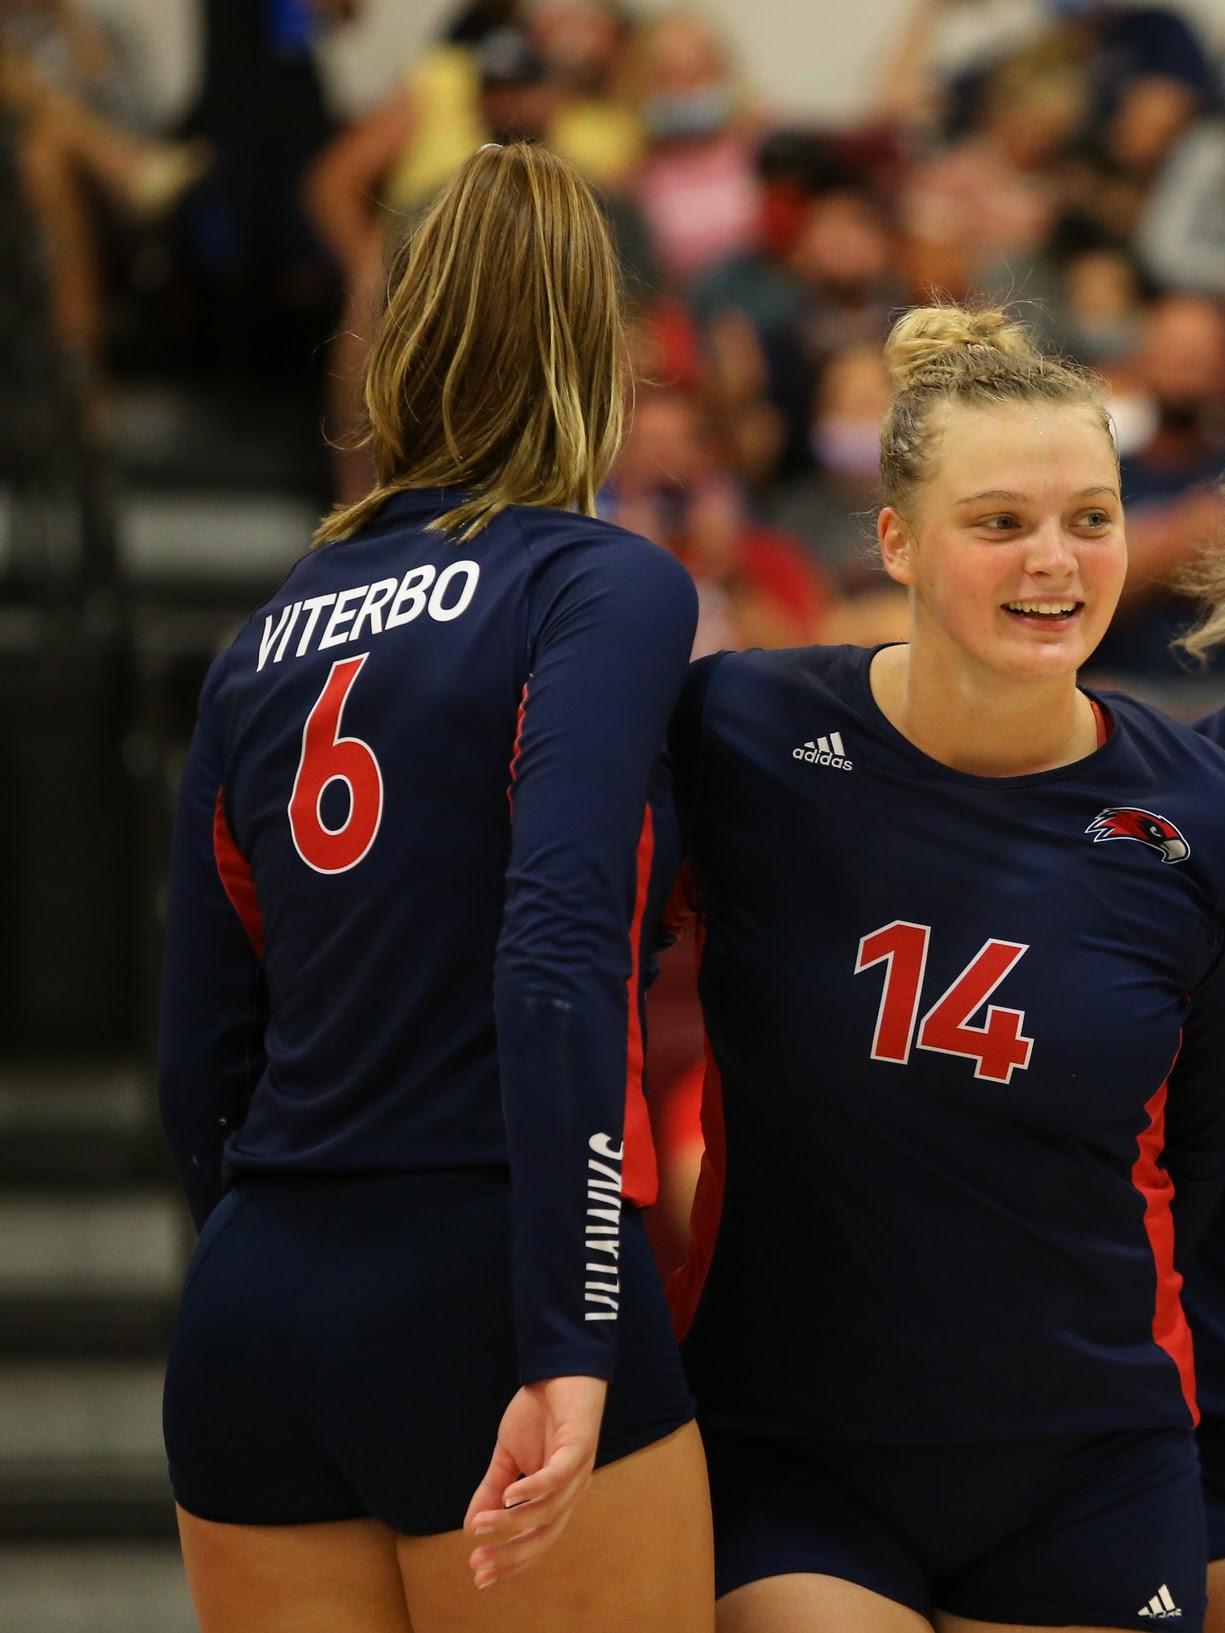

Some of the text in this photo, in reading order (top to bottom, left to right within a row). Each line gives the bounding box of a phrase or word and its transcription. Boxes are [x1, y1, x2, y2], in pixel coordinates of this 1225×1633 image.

[256, 560, 480, 672] VITERBO
[288, 652, 384, 875] 6
[792, 748, 853, 771] adidas
[854, 919, 1035, 1085] 14
